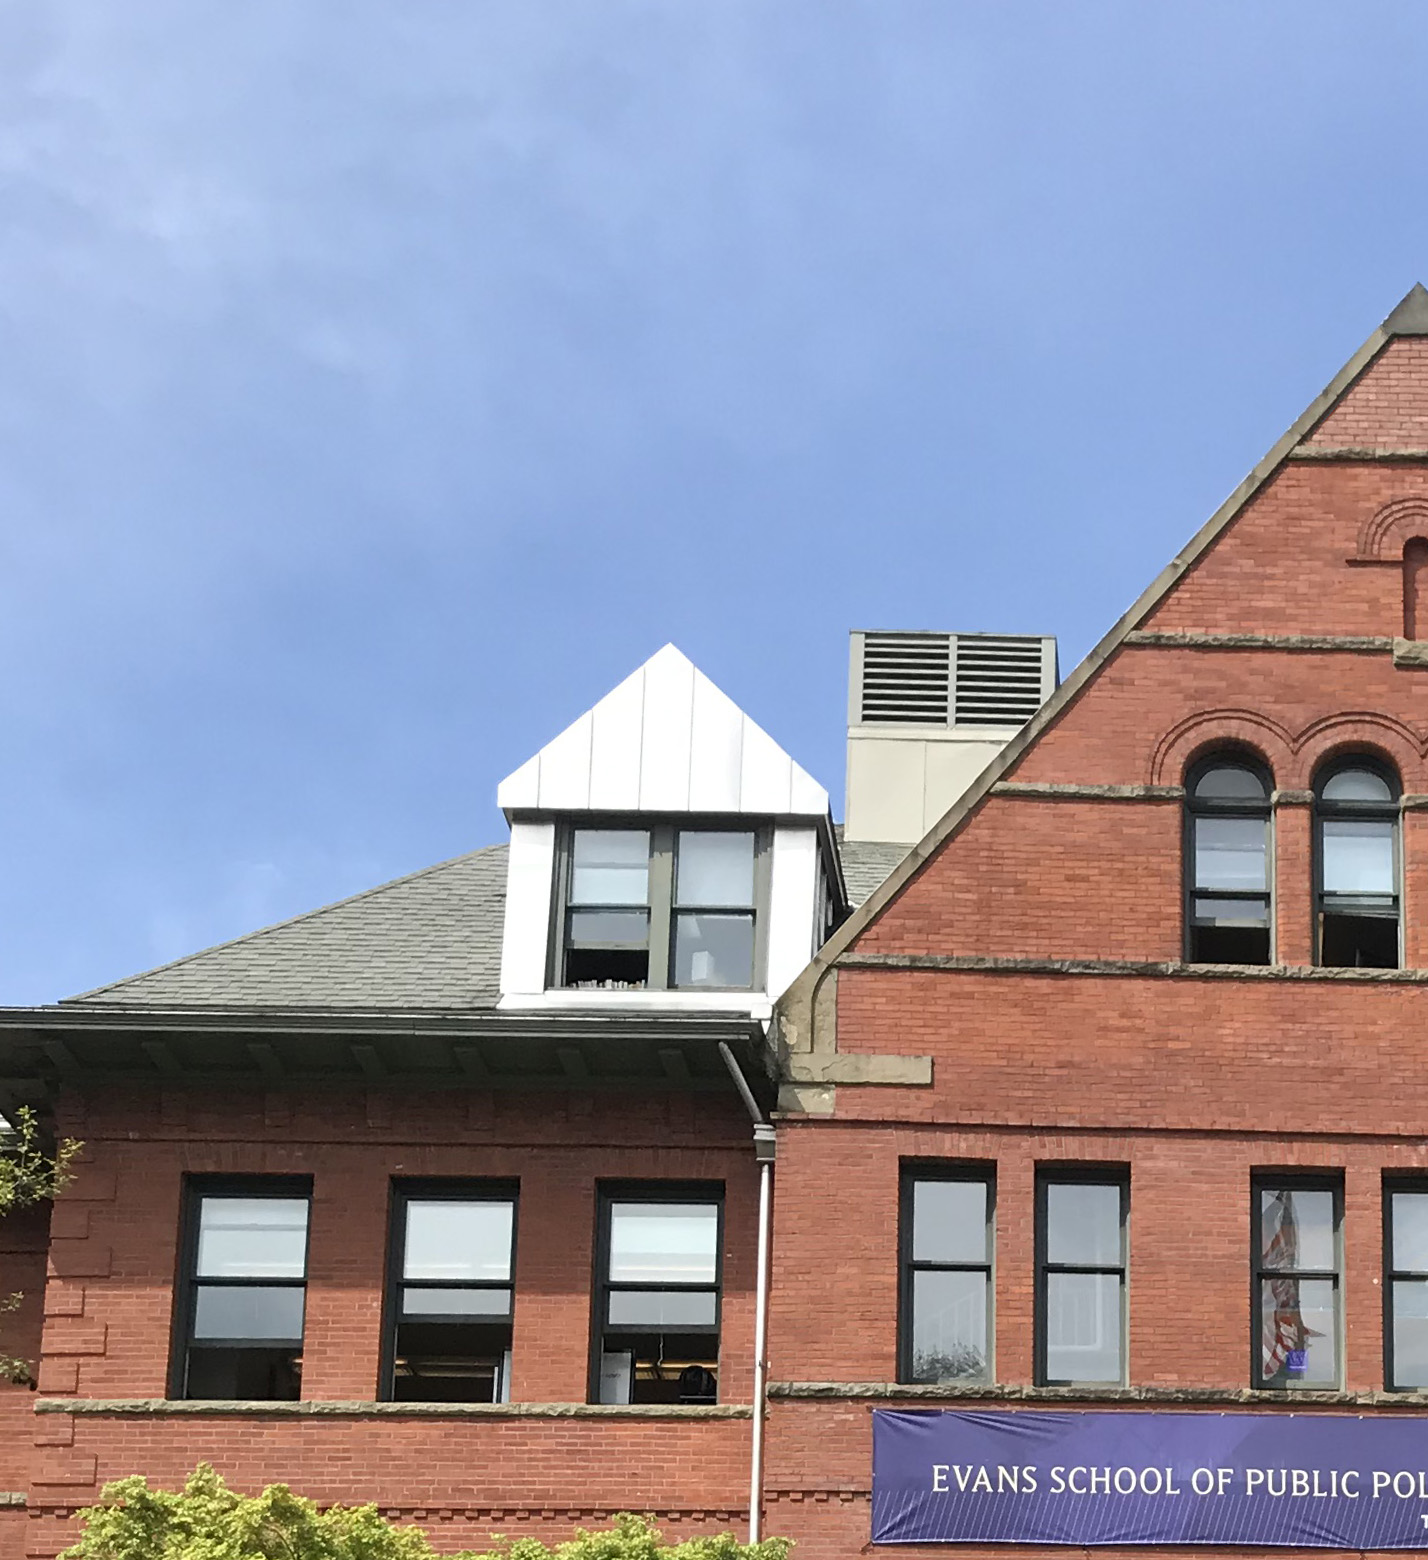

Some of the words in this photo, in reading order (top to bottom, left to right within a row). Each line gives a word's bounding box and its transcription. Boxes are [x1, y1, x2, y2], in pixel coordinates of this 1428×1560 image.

[932, 1464, 1038, 1494] EVANS
[1049, 1466, 1181, 1495] SCHOOL
[1191, 1467, 1234, 1496] OF
[1245, 1468, 1360, 1498] PUBLIC
